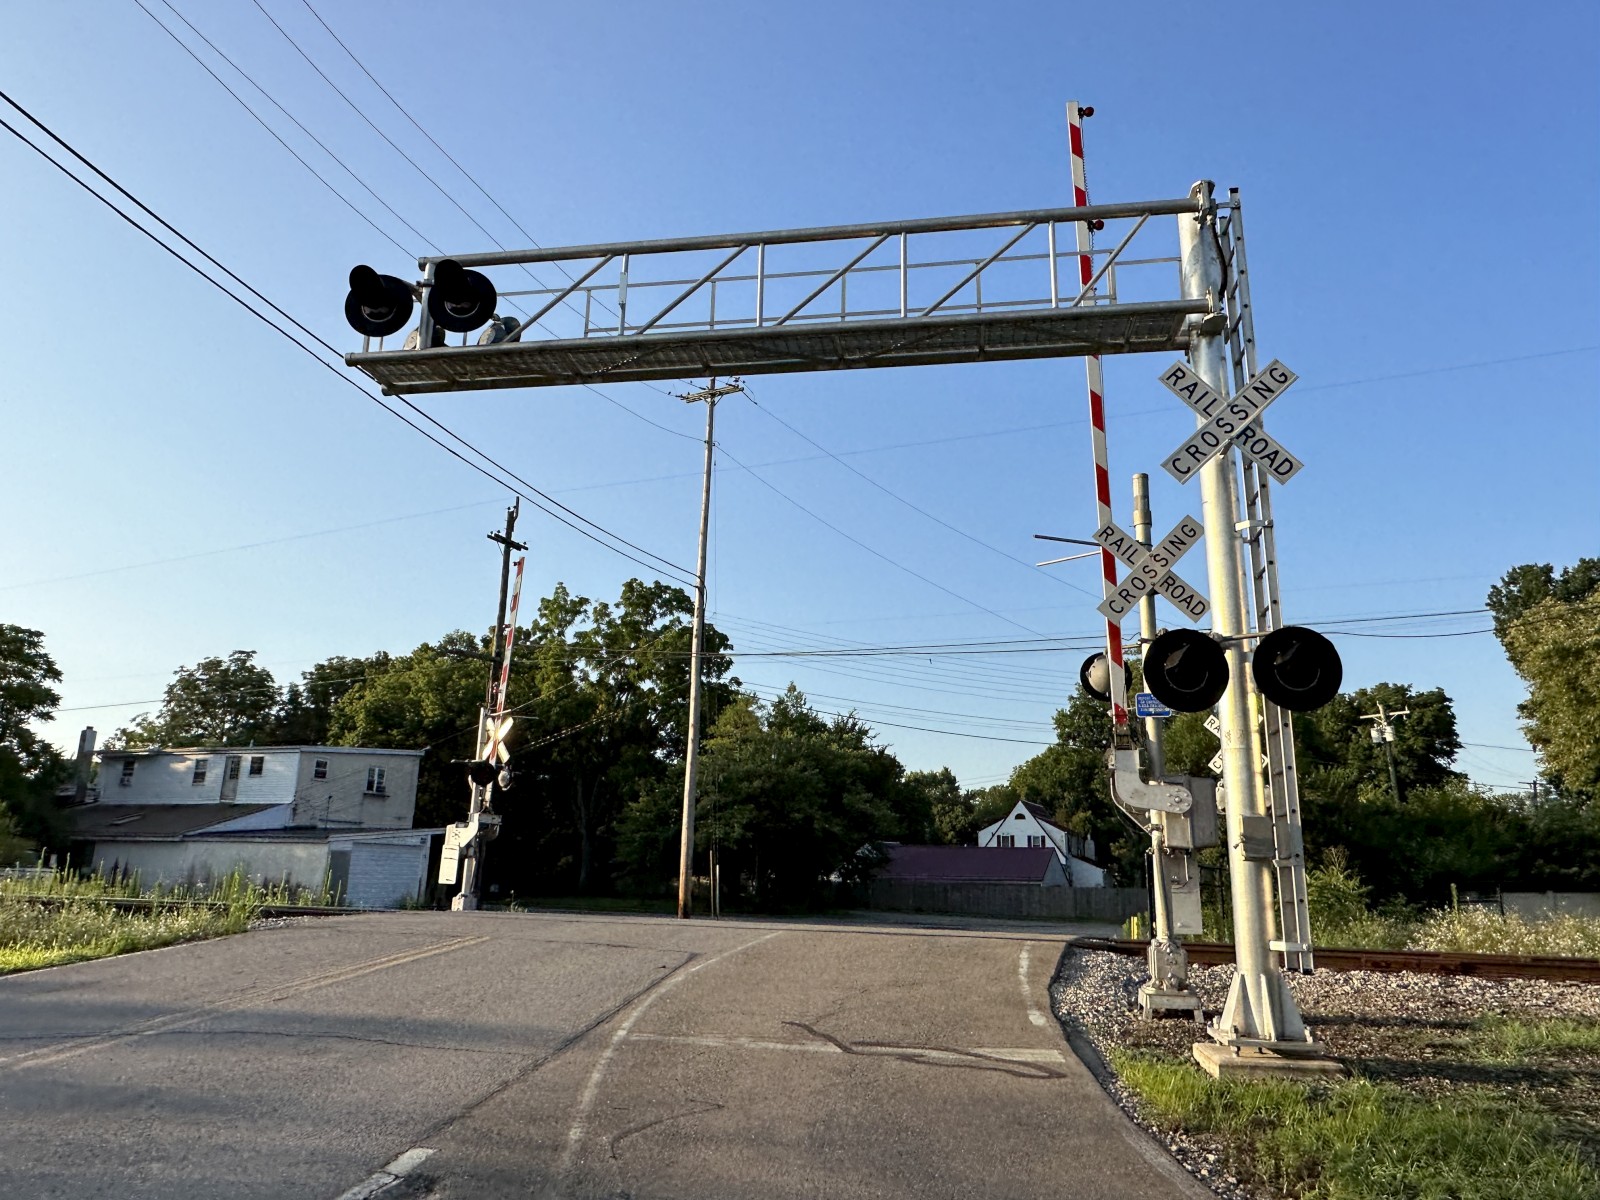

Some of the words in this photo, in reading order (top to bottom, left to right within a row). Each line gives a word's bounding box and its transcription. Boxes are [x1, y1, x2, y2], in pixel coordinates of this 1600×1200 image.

[1166, 367, 1217, 417] RAIL
[1236, 425, 1294, 475] ROAD
[1172, 367, 1288, 475] CROSSING
[1099, 526, 1139, 565] RAIL
[1160, 576, 1206, 616] ROAD
[1109, 524, 1196, 614] CROSSING
